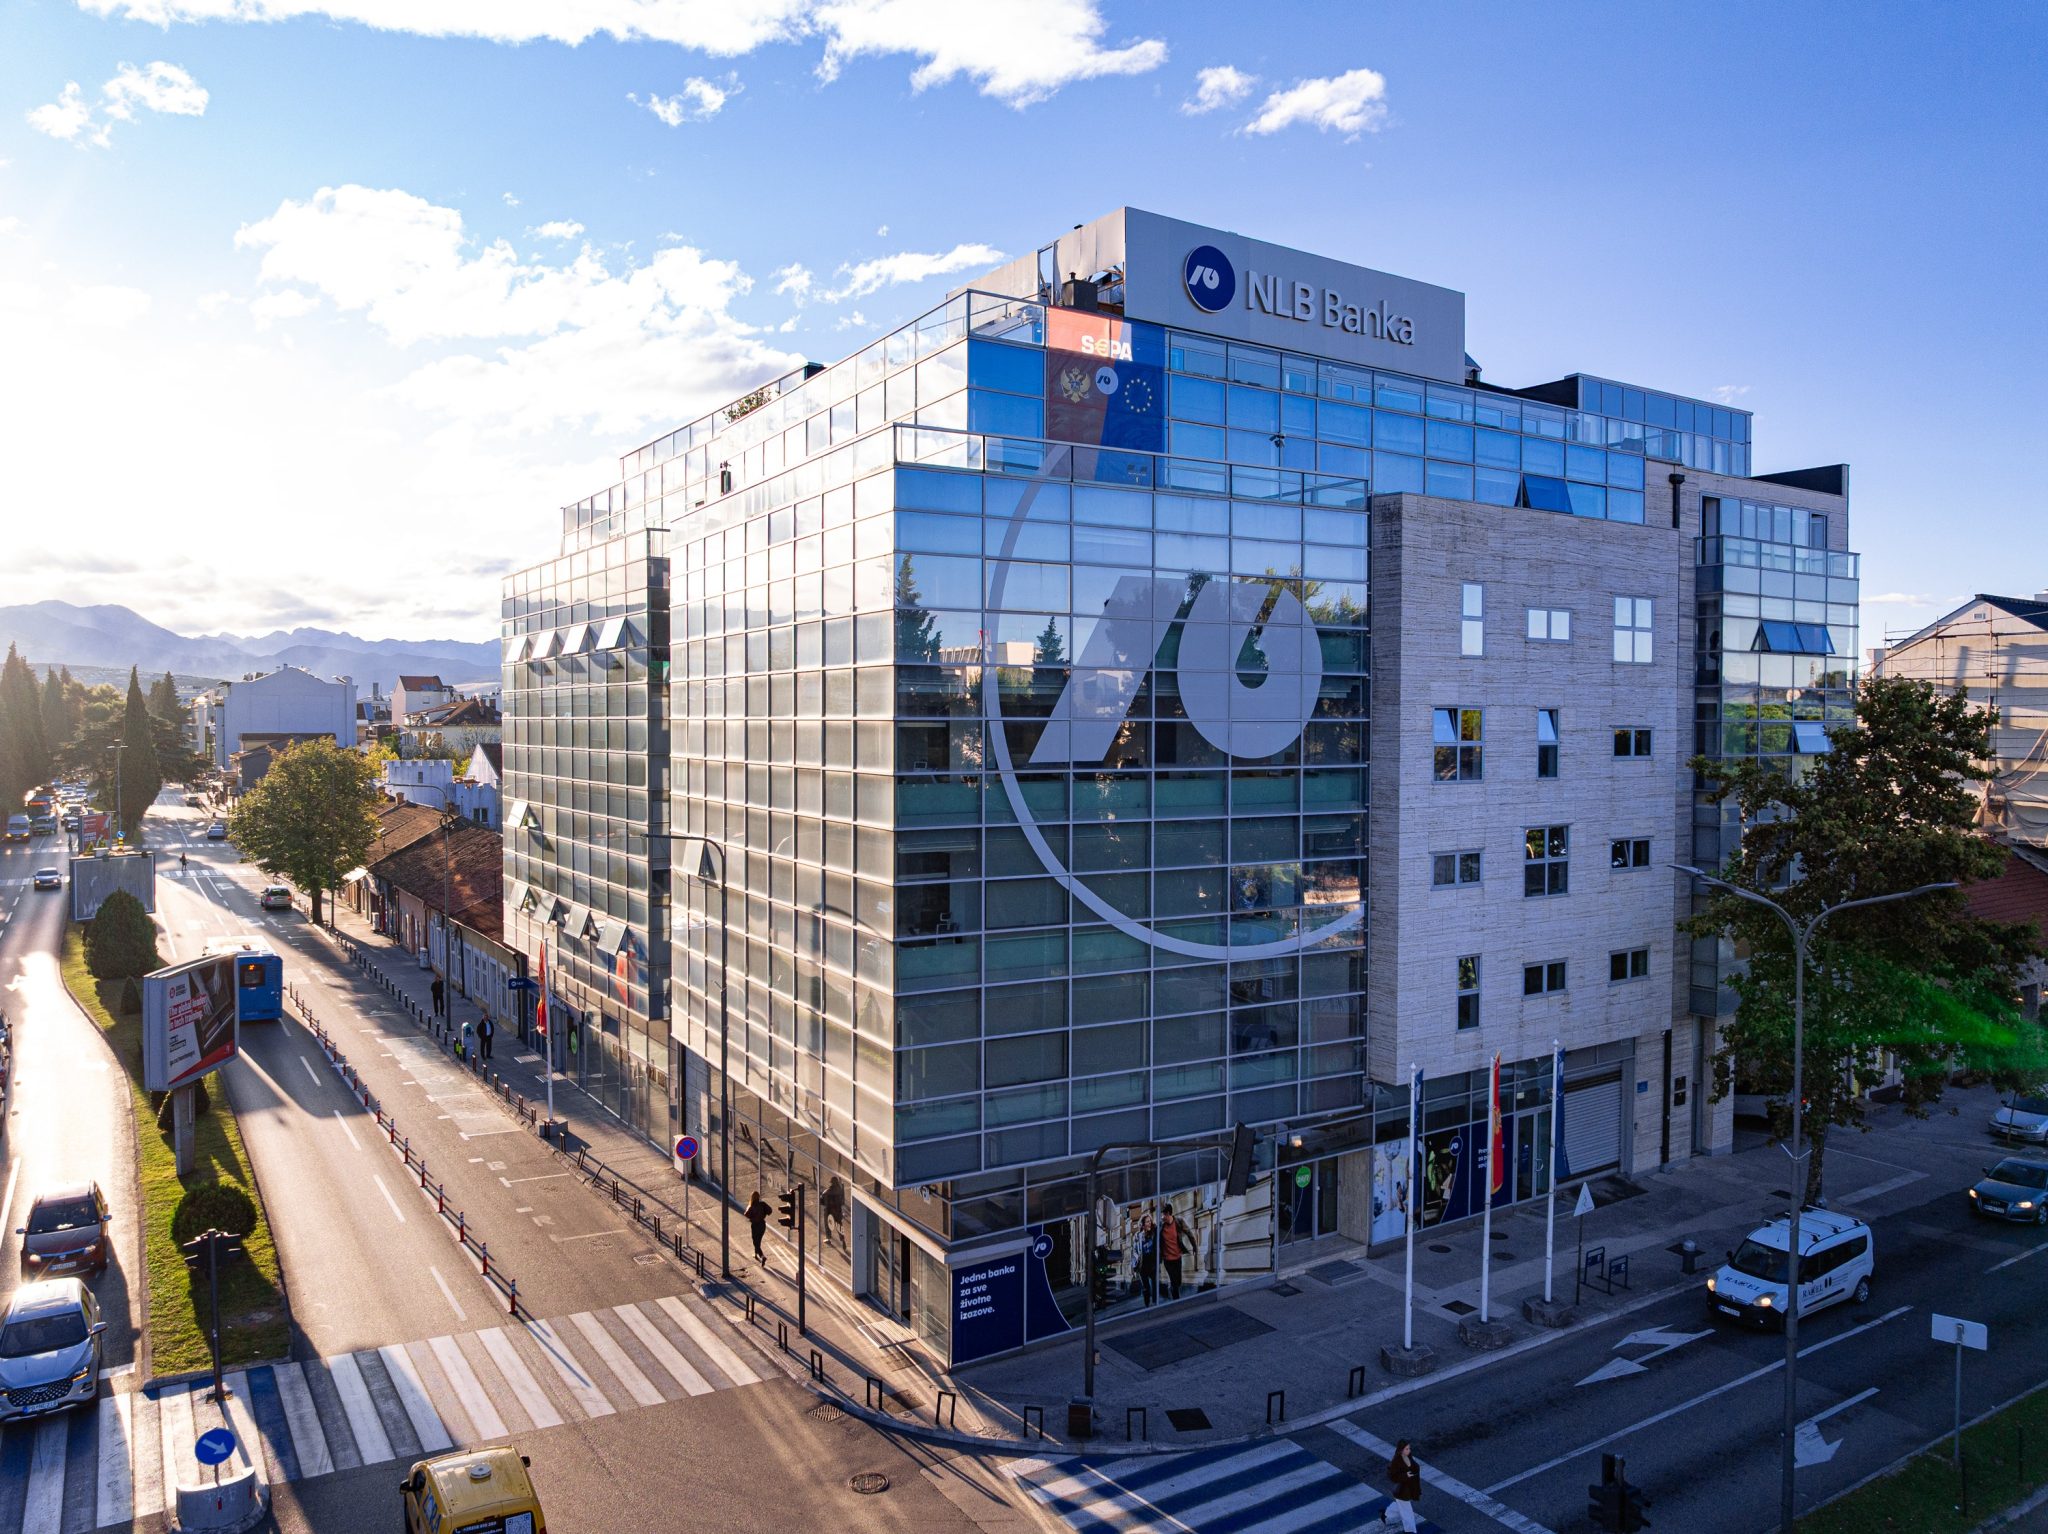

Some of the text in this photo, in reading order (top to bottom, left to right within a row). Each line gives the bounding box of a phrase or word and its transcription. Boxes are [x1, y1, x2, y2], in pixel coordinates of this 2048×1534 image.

[1247, 270, 1416, 345] NLB Banka
[960, 1265, 1015, 1285] Jedna banka
[960, 1284, 987, 1297] za sve
[960, 1294, 992, 1309] životne
[960, 1306, 996, 1320] izazove.
